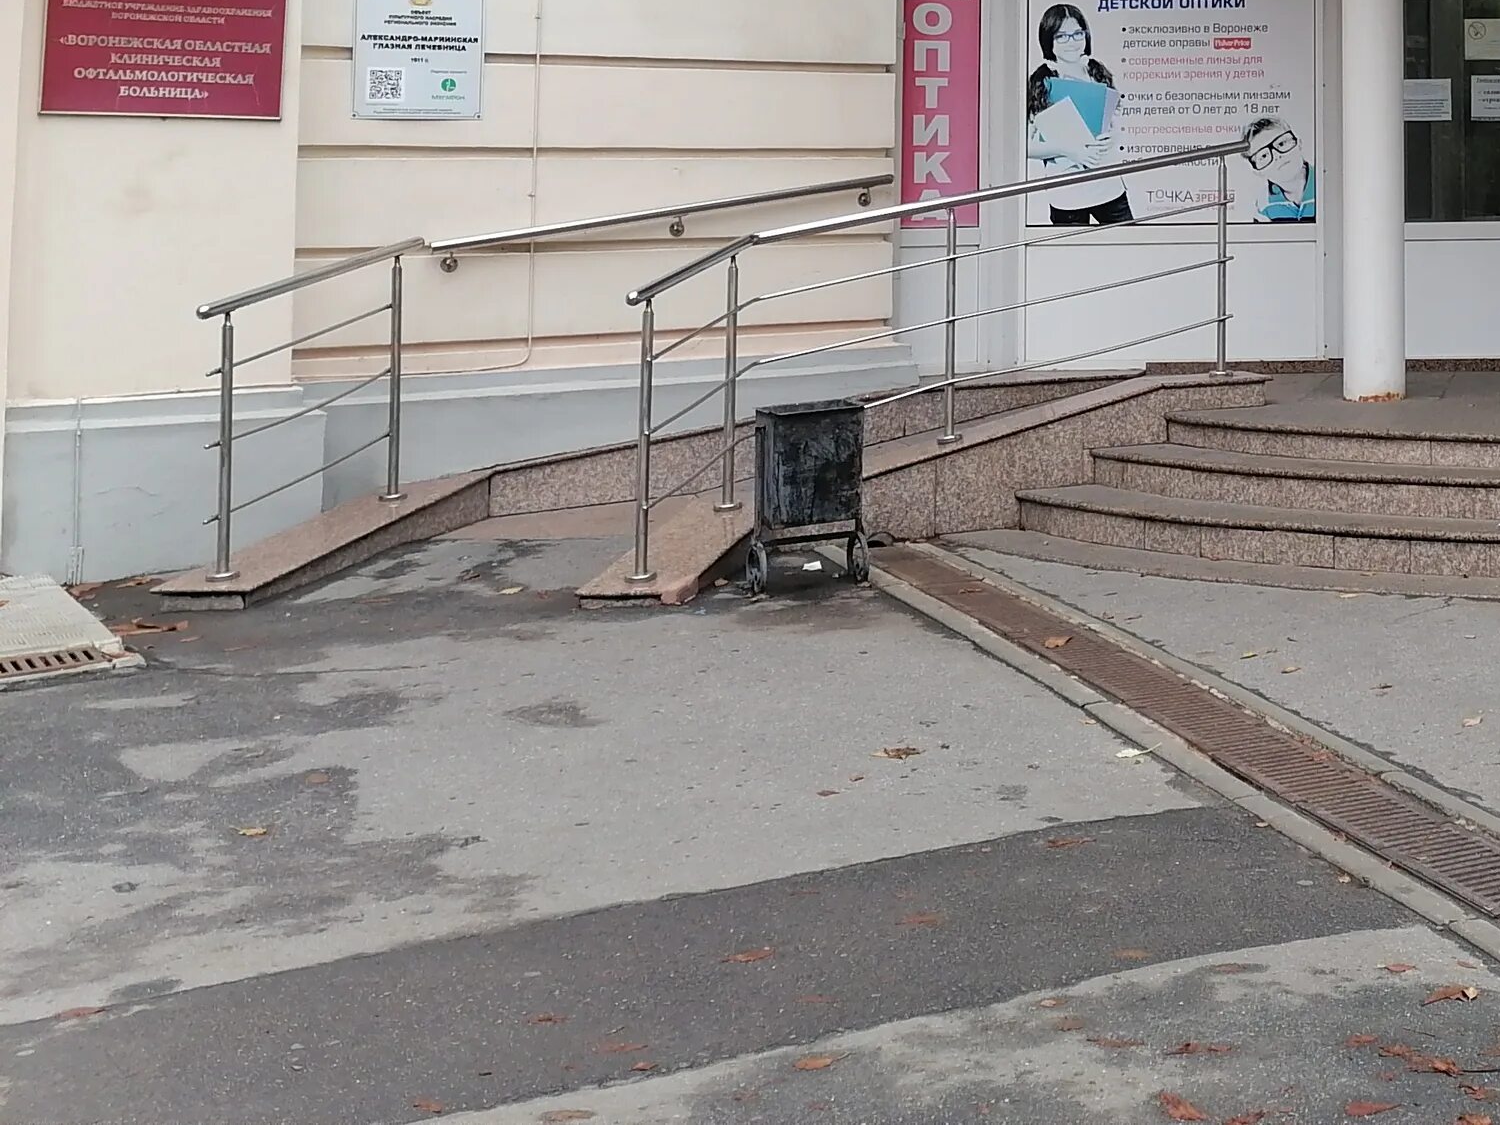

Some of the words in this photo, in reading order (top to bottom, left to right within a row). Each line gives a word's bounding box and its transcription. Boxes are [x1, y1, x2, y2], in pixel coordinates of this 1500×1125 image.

[1128, 25, 1201, 35] эксклюзивно
[1203, 25, 1210, 33] в
[1213, 23, 1268, 35] Воронеже
[59, 34, 182, 50] «ВОРОНЕЖСКАЯ
[184, 40, 272, 54] ОБЛАСТНАЯ
[360, 33, 479, 43] АЛЕКСАНДРО-МАРИИНСКАЯ
[1123, 39, 1167, 49] детские
[1169, 39, 1211, 49] оправы
[414, 44, 467, 52] ЛЕЧЕБНИЦА
[110, 53, 222, 68] КЛИНИЧЕСКАЯ
[1128, 56, 1204, 67] современные
[1206, 56, 1241, 65] линзы
[1243, 56, 1263, 66] для
[74, 67, 254, 85] ОФТАЛЬМОЛОГИЧЕСКАЯ
[1123, 70, 1181, 81] коррекции
[1183, 70, 1222, 81] зрения
[1225, 70, 1230, 80] у
[1232, 68, 1264, 79] детей
[119, 85, 209, 100] БОЛЬНИЦА»
[1127, 92, 1154, 101] очки
[1156, 92, 1162, 100] с
[1165, 90, 1241, 101] безопасными
[1243, 91, 1291, 100] линзами
[911, 2, 953, 221] ОПТИКА
[1122, 107, 1142, 117] для
[1143, 104, 1175, 116] детей
[1178, 106, 1190, 115] от
[1203, 105, 1223, 114] лет
[1223, 105, 1238, 115] до
[1243, 104, 1259, 114] 18
[1261, 105, 1280, 114] лет
[1127, 125, 1213, 136] прогрессивные
[1215, 125, 1241, 134] очки
[1145, 189, 1194, 203] ТОЧКА
